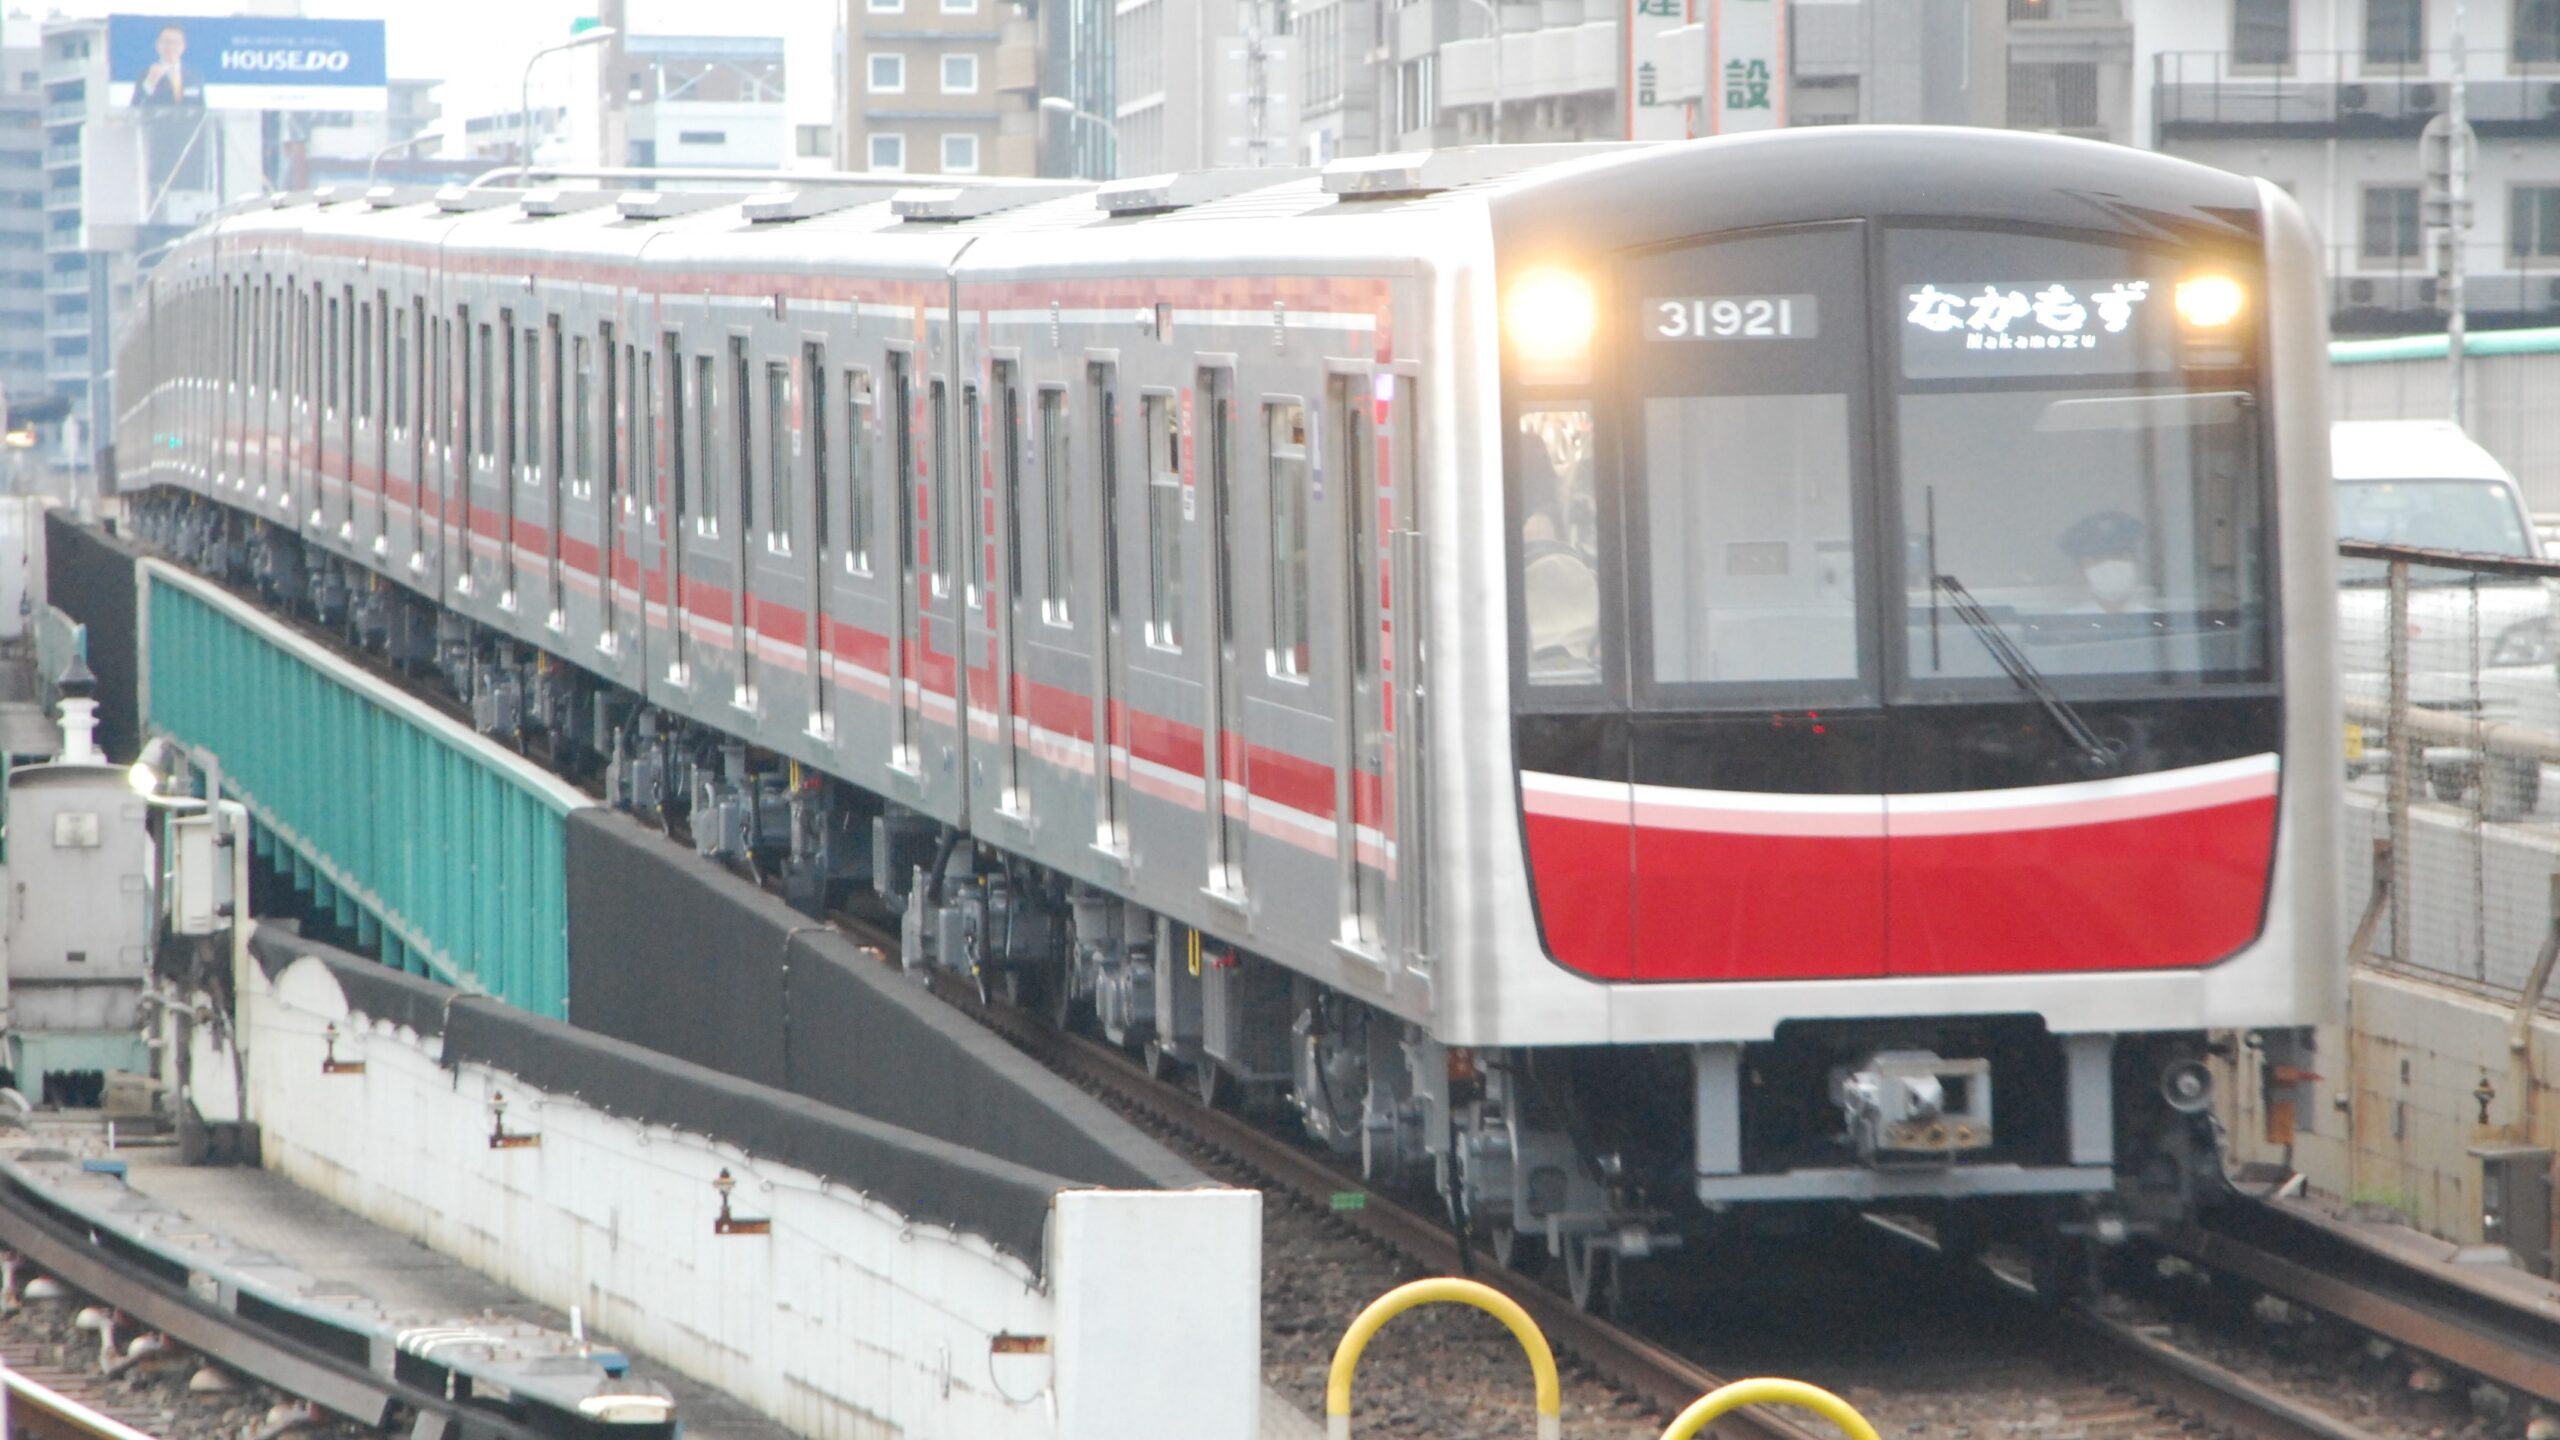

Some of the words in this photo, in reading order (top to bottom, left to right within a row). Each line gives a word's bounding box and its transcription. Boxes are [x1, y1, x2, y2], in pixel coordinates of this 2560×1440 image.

[1657, 299, 1792, 337] 31921
[1907, 281, 2150, 332] なかもず
[1966, 333, 2096, 349] Nakamozu
